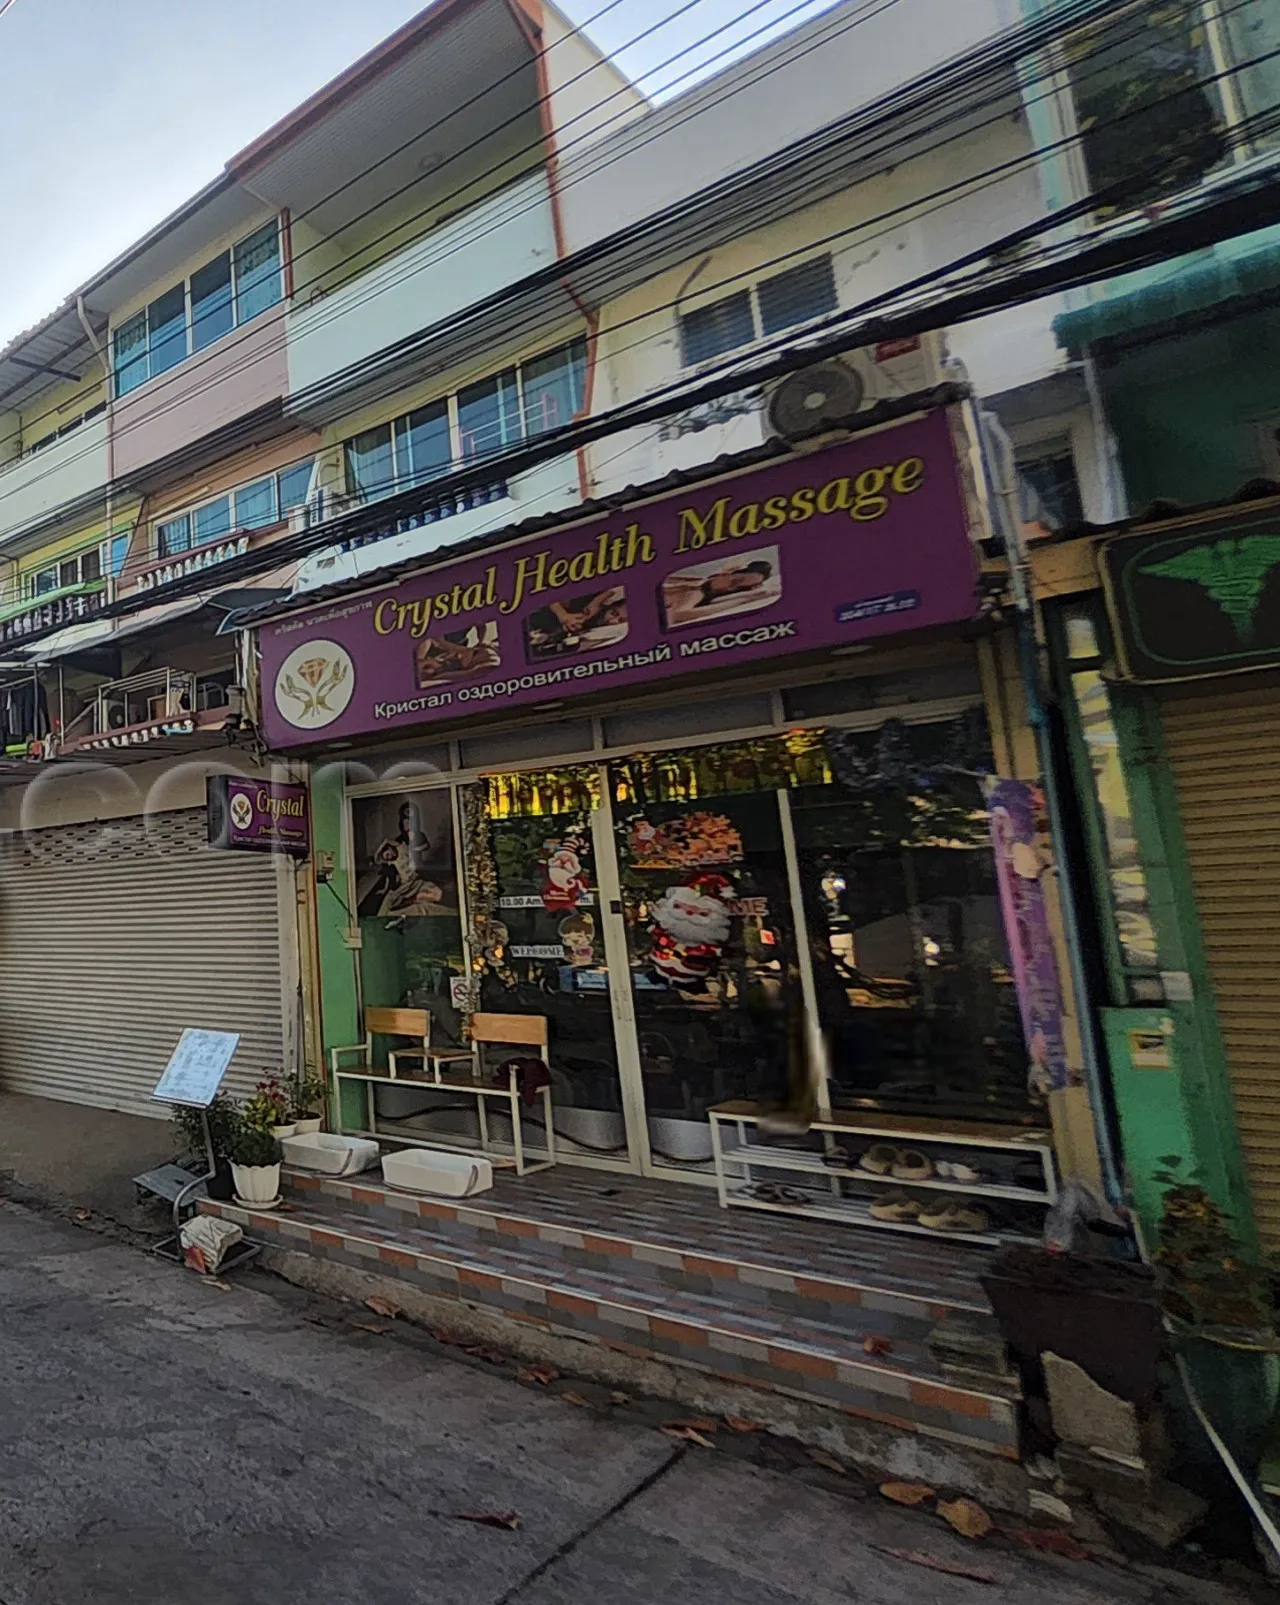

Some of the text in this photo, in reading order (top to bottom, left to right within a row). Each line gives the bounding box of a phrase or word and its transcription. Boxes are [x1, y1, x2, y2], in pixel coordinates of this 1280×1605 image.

[373, 457, 925, 640] Crystal Health Massage
[374, 622, 795, 719] Кристал оздоровительный массаж
[256, 789, 304, 821] Crystal
